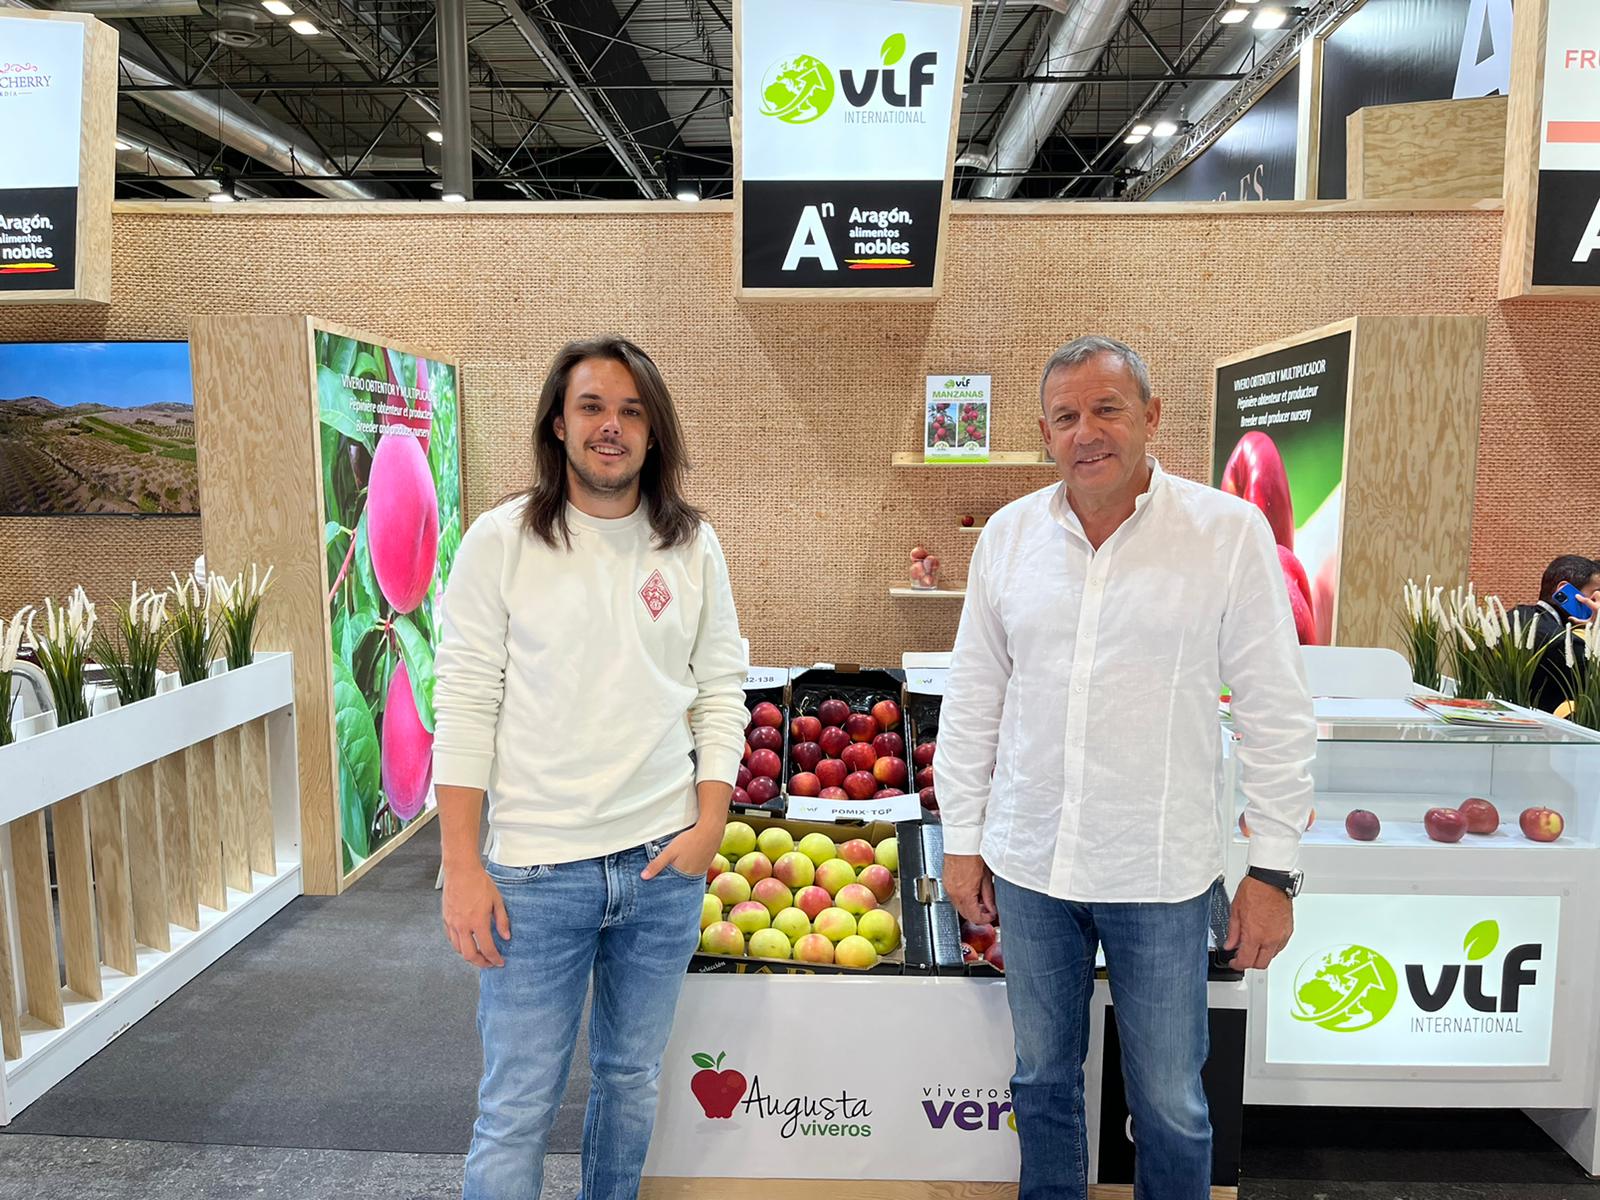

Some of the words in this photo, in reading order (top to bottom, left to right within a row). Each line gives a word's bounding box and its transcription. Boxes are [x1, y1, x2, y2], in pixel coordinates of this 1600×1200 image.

[1564, 49, 1600, 69] FR
[0, 75, 52, 89] CHERRY
[844, 110, 926, 124] INTERNATIONAL
[849, 207, 913, 228] Aragón,
[0, 232, 43, 244] limentos
[849, 227, 900, 238] alimentos
[2, 243, 53, 259] nobles
[854, 239, 910, 255] nobles
[1275, 369, 1281, 383] Y
[1280, 359, 1326, 382] MULTIPLICADOR
[342, 375, 365, 390] VIVERO
[932, 390, 984, 398] MANZANAS
[1281, 389, 1288, 402] et
[1286, 385, 1319, 404] producteur
[1290, 408, 1312, 423] nursery
[1410, 1017, 1523, 1034] INTERNATIONAL
[923, 1084, 1012, 1098] viveros
[741, 1075, 873, 1138] Augusta
[799, 1120, 872, 1137] viveros
